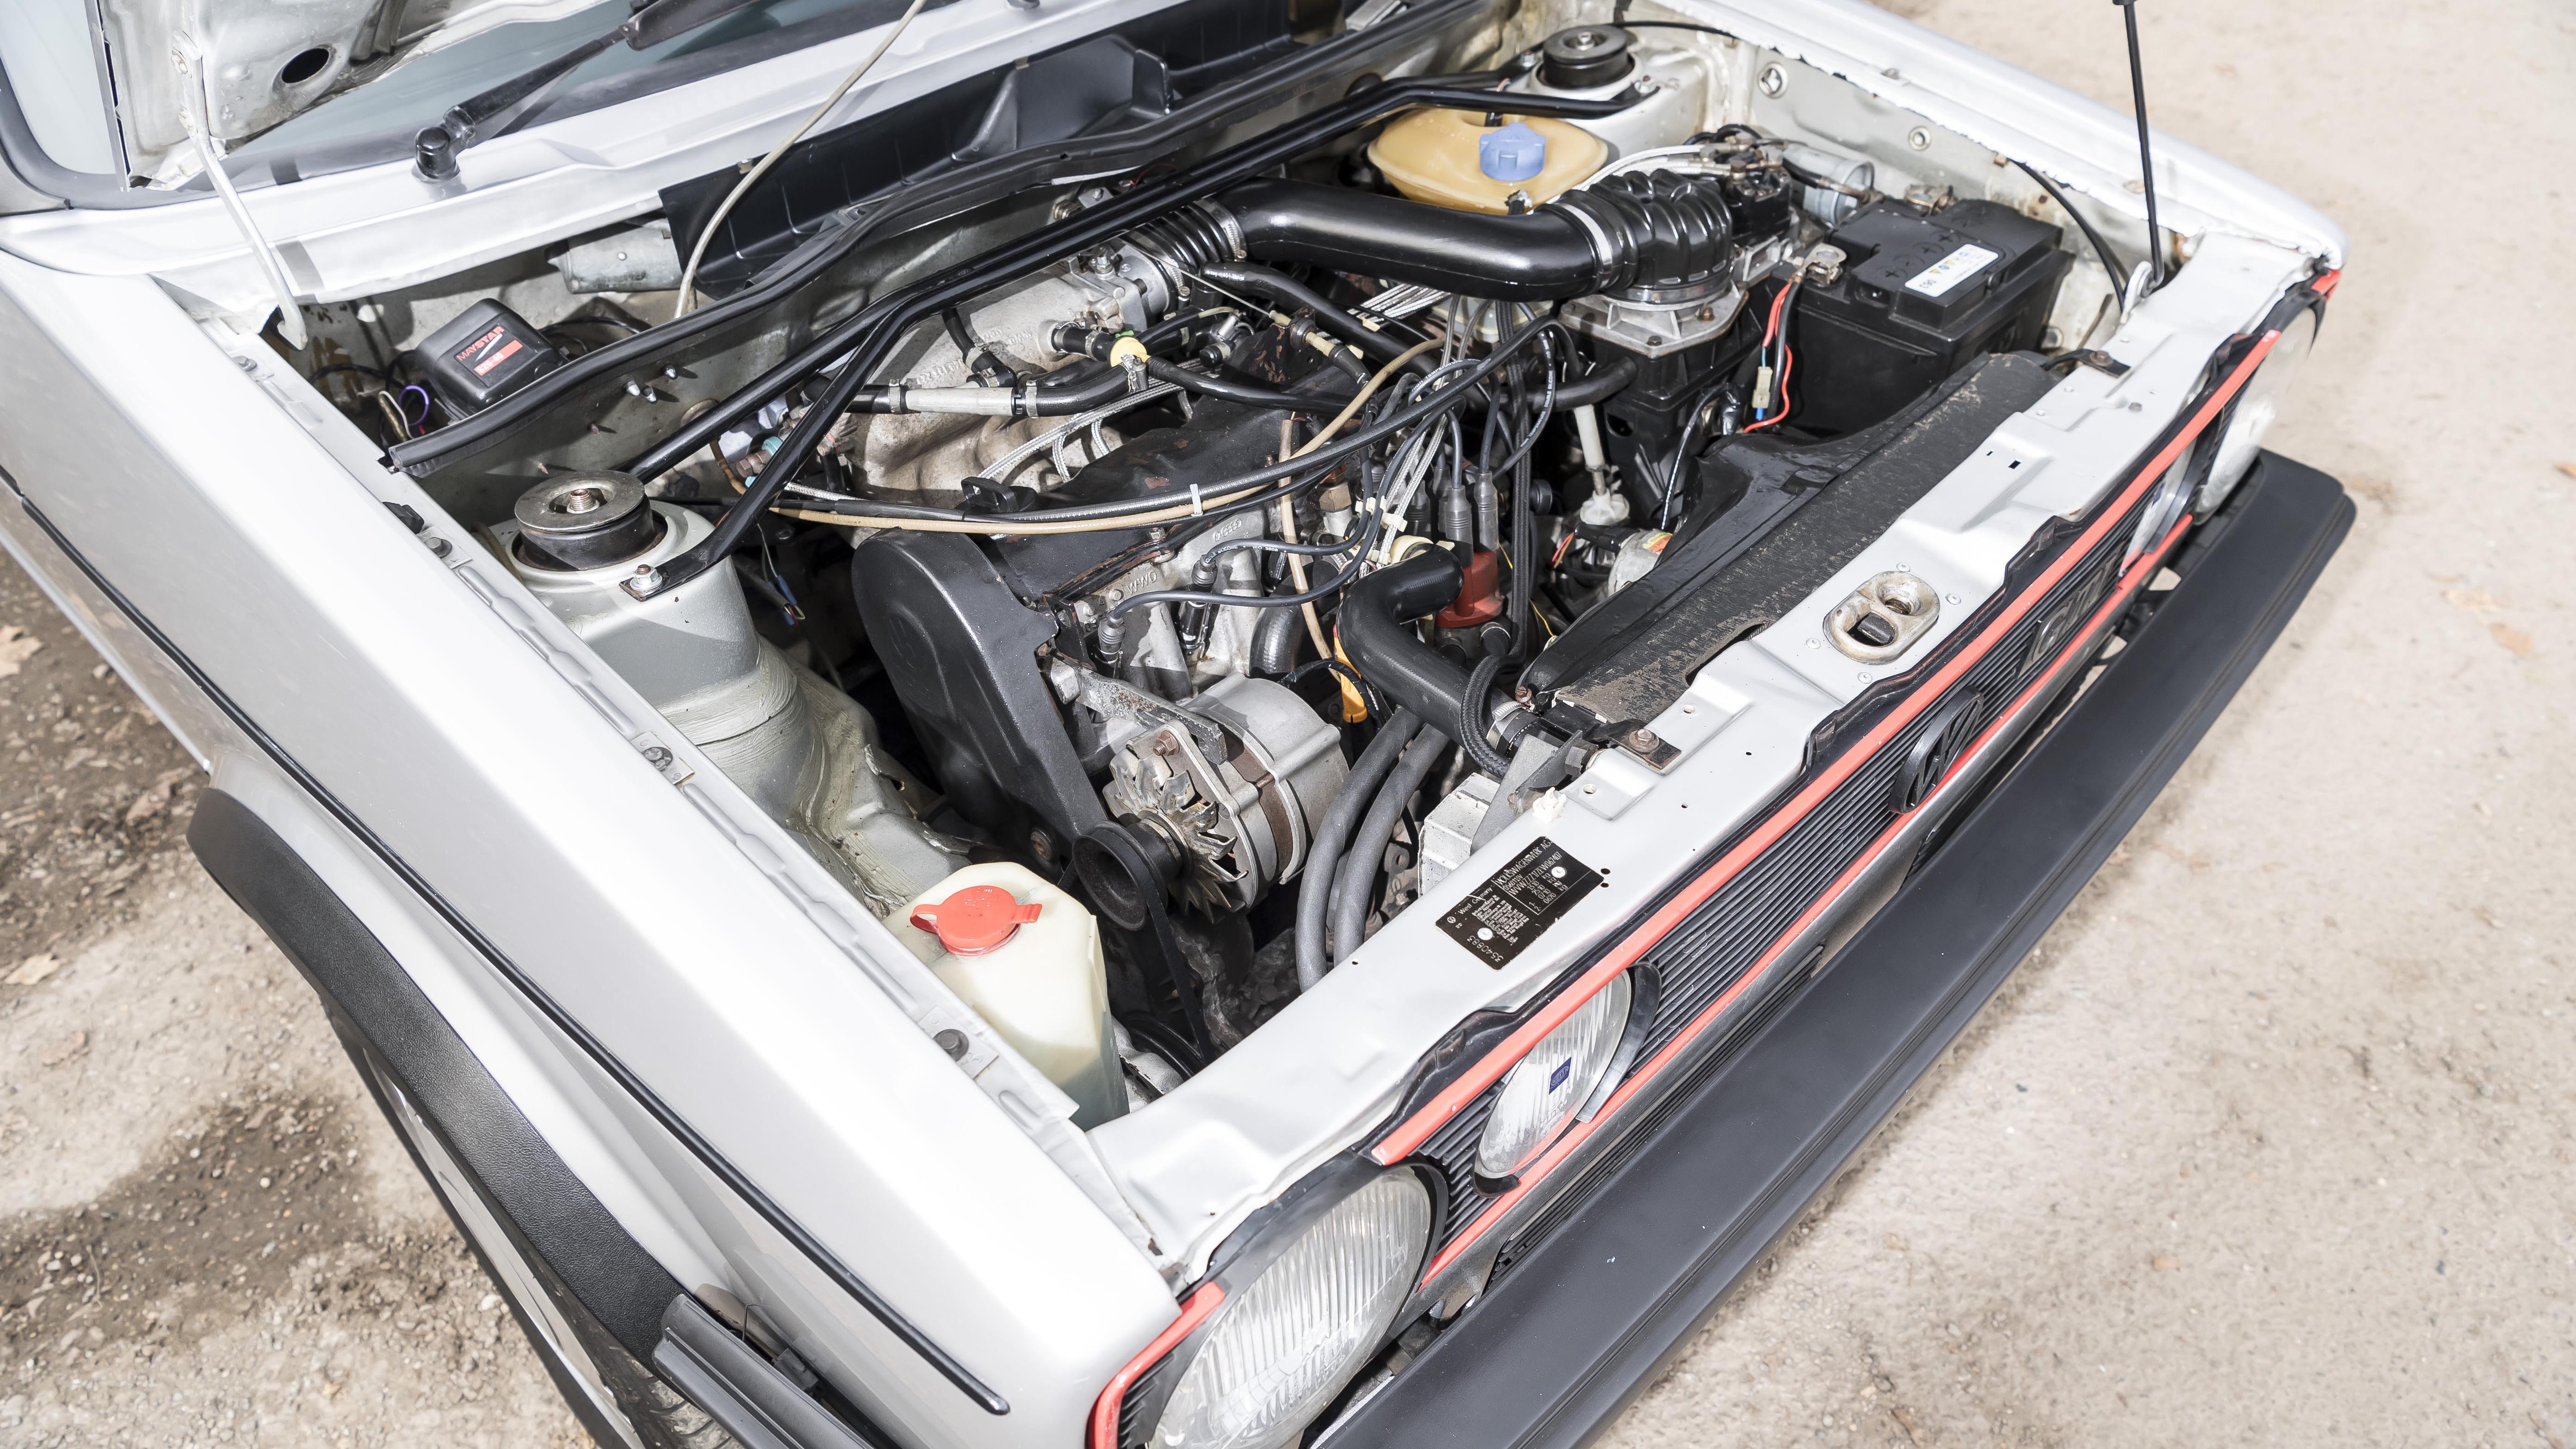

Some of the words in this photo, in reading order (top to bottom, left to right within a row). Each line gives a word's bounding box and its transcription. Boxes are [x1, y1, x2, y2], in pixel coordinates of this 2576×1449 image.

[456, 326, 505, 361] MAYSTAR
[1495, 847, 1542, 885] VOLKSWAGENWERK
[1527, 880, 1539, 890] 1310
[1532, 885, 1545, 895] 2510
[1458, 903, 1472, 914] West
[1467, 935, 1504, 962] 3540883
